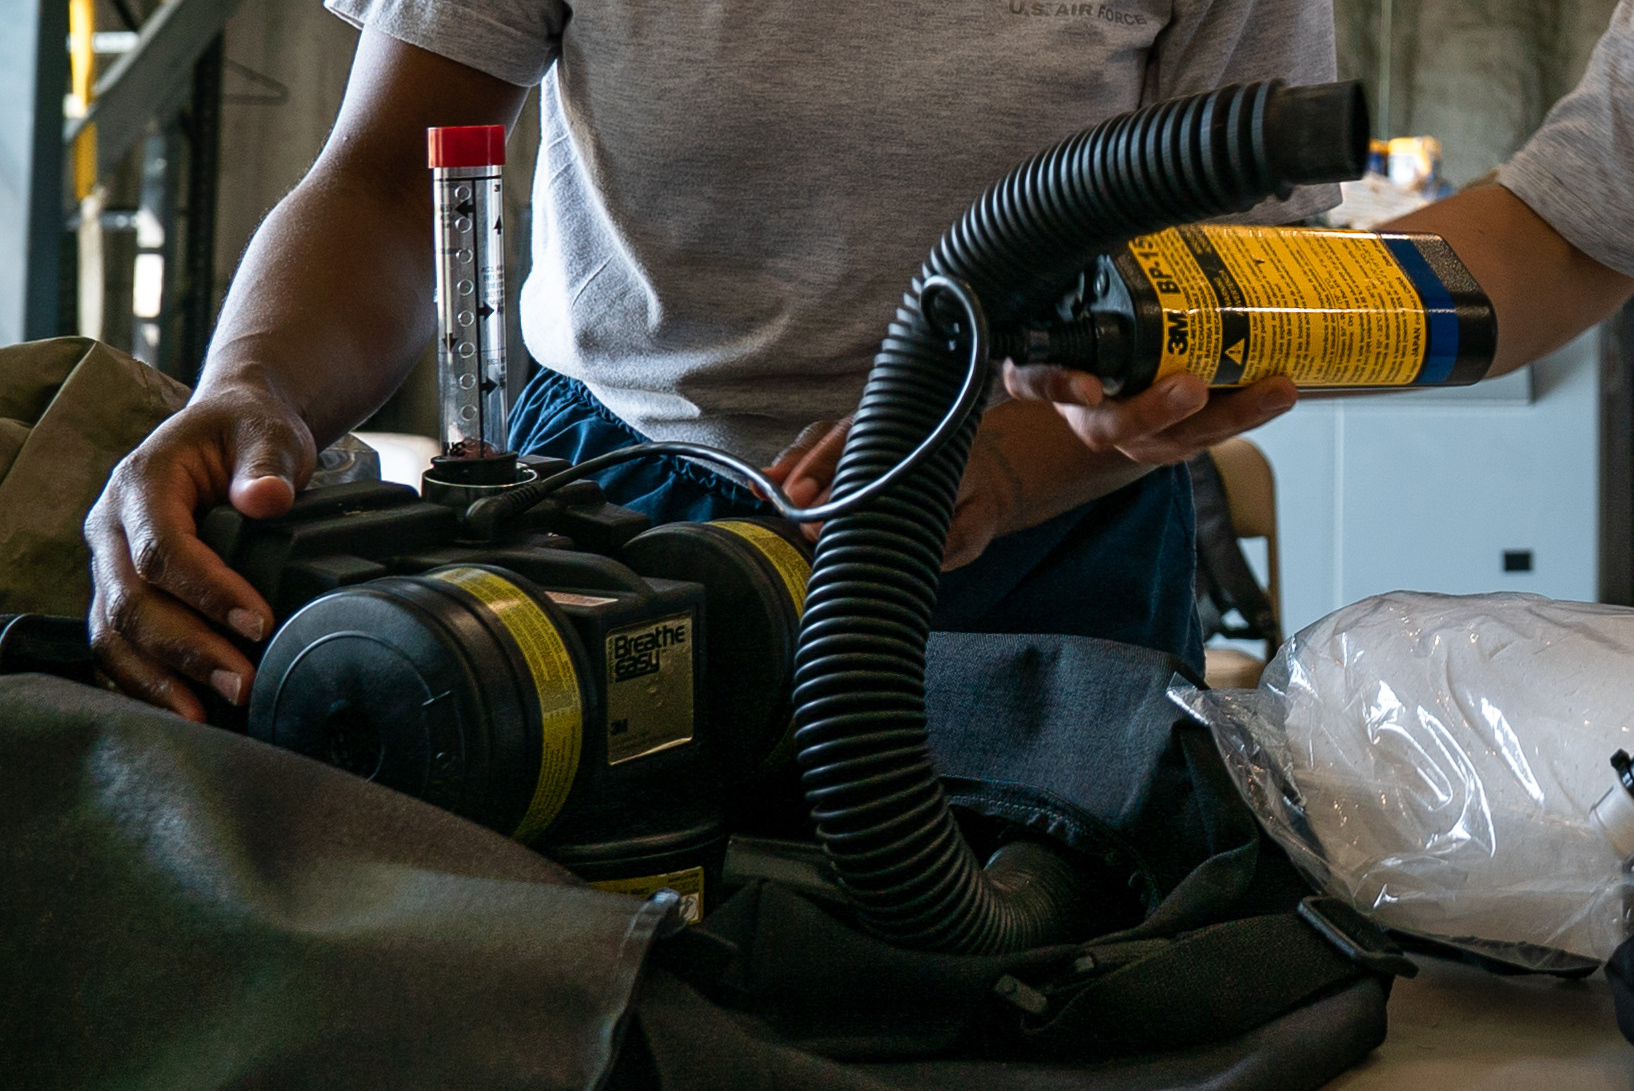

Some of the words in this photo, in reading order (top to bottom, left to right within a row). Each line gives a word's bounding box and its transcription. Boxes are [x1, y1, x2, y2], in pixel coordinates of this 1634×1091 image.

[1009, 0, 1049, 17] U.S.
[1055, 3, 1093, 16] AIR
[1097, 4, 1147, 26] FORCE
[1132, 237, 1181, 294] BP-15
[1167, 311, 1188, 355] 3M
[1411, 327, 1421, 358] JAPAN
[614, 625, 686, 659] Breathe
